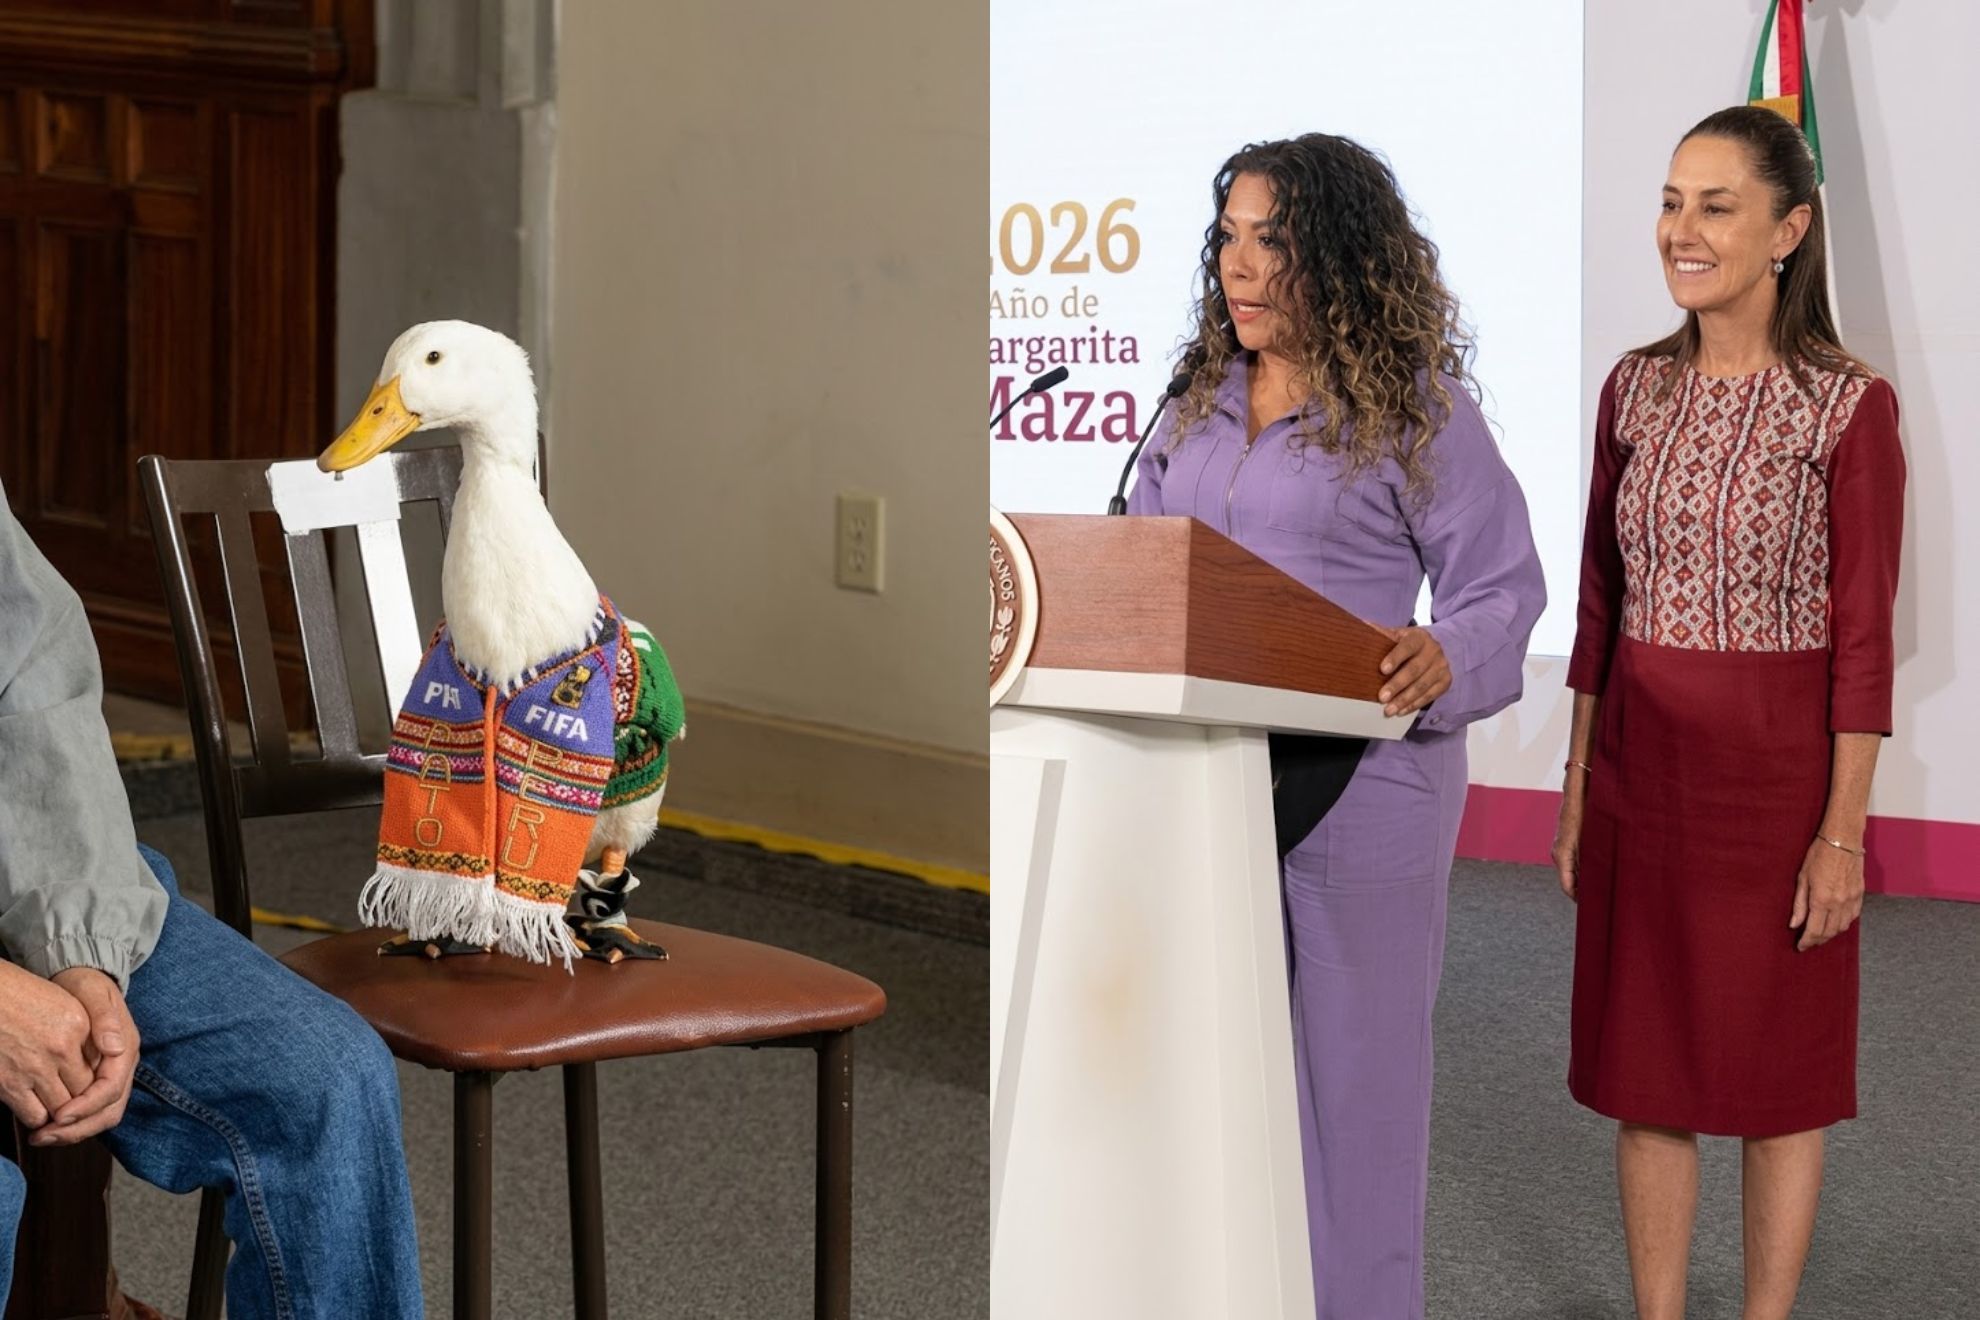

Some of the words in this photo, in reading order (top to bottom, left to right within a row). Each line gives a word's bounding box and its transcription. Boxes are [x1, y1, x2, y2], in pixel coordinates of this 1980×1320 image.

[990, 198, 1141, 276] 026
[990, 287, 1049, 319] Año
[1061, 285, 1099, 318] de
[990, 325, 1140, 374] argarita
[523, 704, 588, 742] FIFA
[501, 739, 563, 870] PERU
